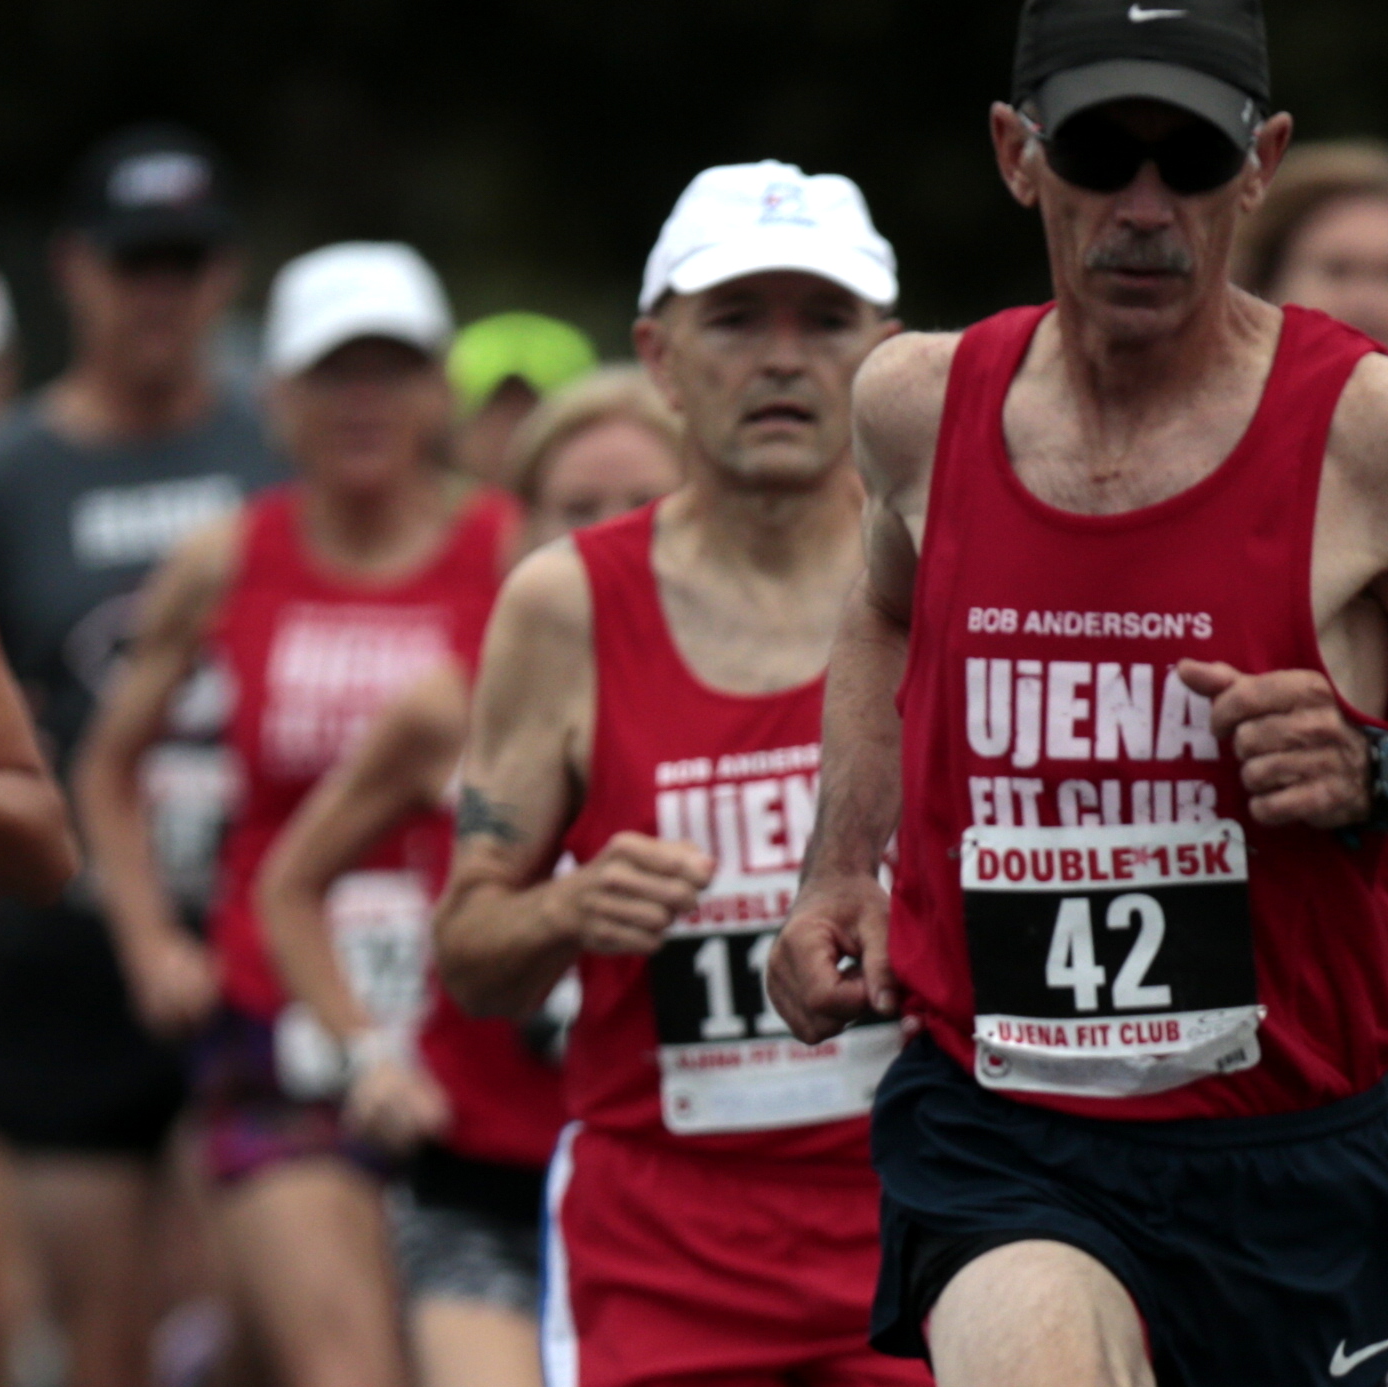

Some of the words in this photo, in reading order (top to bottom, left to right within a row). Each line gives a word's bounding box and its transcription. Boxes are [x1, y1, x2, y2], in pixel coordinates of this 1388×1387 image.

[968, 606, 1018, 633] BOB
[1023, 610, 1214, 640] ANDERSON'S
[977, 849, 1136, 883] DOUBLE
[1148, 840, 1233, 878] 15K
[1046, 892, 1172, 1012] 42
[997, 1021, 1069, 1049] UJENA
[1076, 1022, 1111, 1049] FIT
[1118, 1019, 1182, 1046] CLUB
